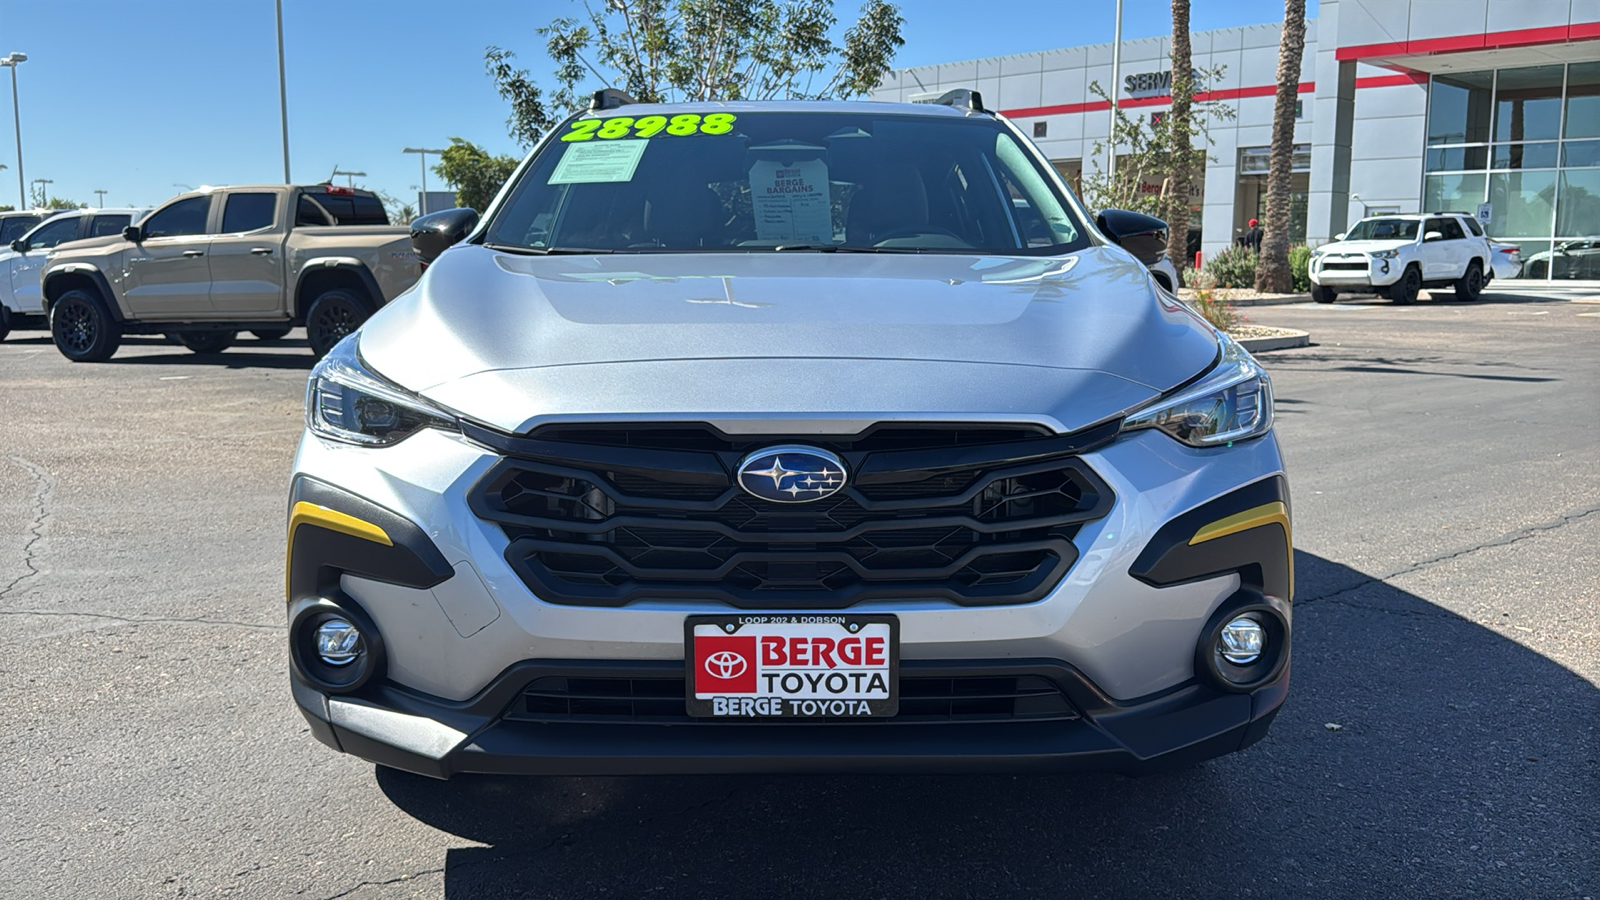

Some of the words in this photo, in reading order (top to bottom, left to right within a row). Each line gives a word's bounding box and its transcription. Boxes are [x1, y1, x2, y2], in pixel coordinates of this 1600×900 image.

[561, 113, 737, 142] 28988
[766, 185, 814, 194] BARGAINS
[775, 179, 804, 187] BERGE
[1142, 182, 1163, 196] Berg
[738, 616, 768, 624] LOOP
[770, 616, 788, 624] 202
[790, 616, 798, 624] &
[801, 616, 846, 624] DOBSON
[760, 636, 885, 669] BERGE
[761, 672, 888, 694] TOYOTA
[712, 697, 783, 717] BERGE
[789, 700, 872, 716] TOYOTA
